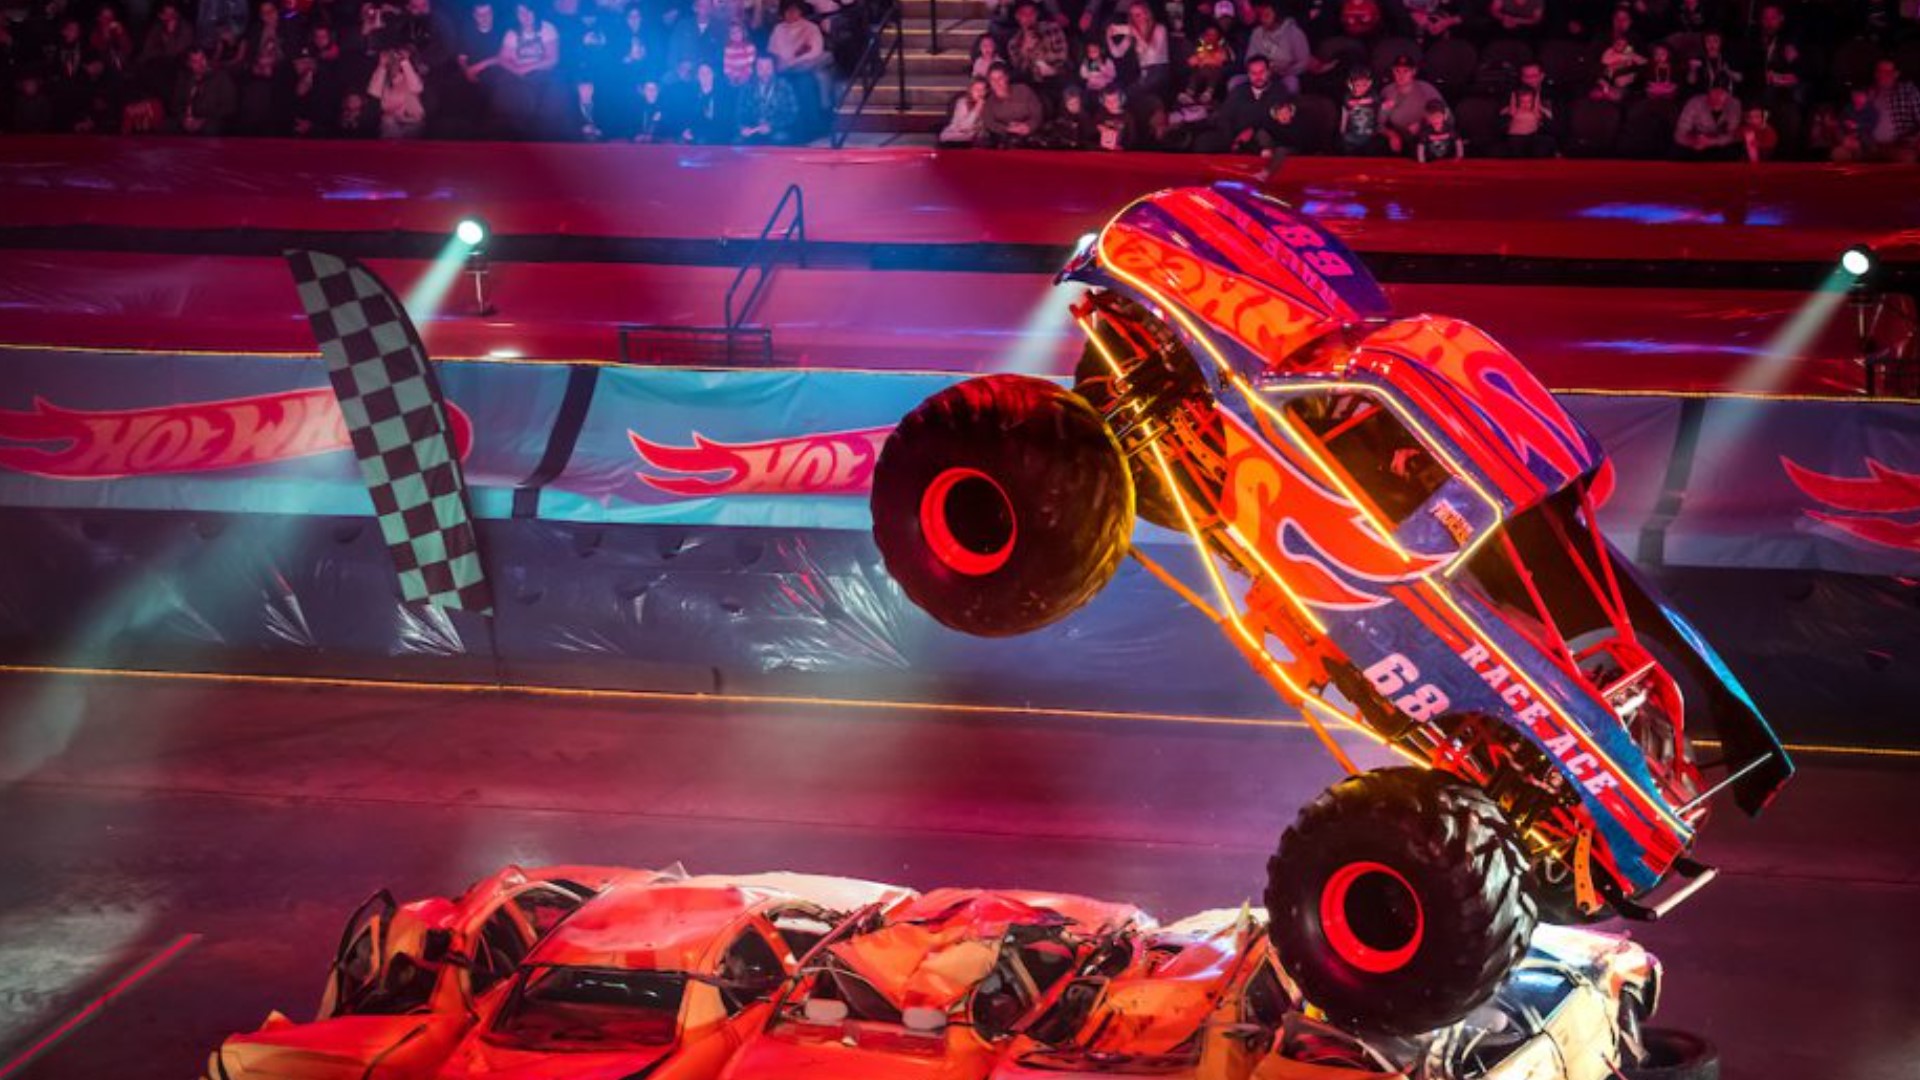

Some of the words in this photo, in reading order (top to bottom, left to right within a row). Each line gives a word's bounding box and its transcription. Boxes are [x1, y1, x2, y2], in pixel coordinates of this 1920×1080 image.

[68, 410, 224, 473] HOT
[728, 440, 868, 493] HOT
[1363, 652, 1450, 723] 68
[1460, 640, 1551, 725] RACE
[1545, 728, 1618, 794] ACE
